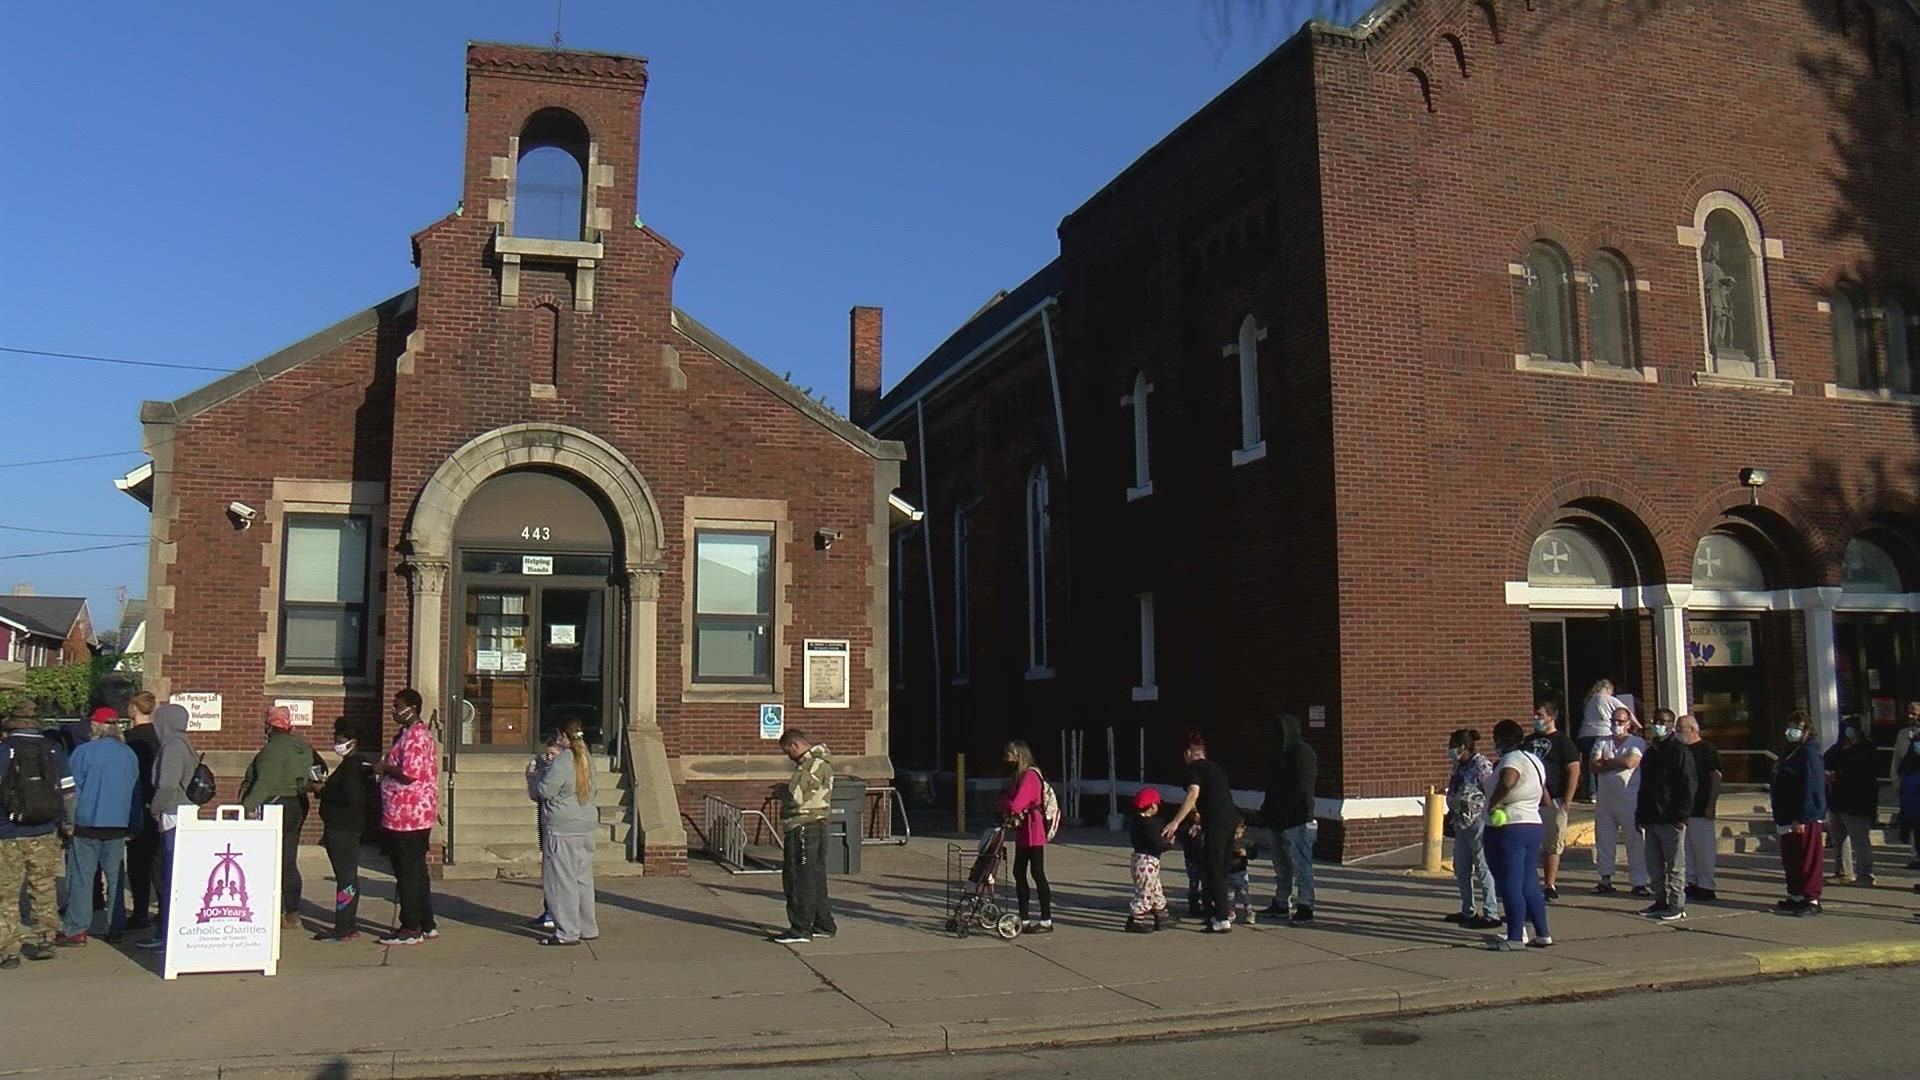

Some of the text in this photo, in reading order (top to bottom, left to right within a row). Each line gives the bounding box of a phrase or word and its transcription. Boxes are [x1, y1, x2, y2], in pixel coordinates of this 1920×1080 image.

[521, 526, 551, 541] 443
[525, 558, 551, 566] Helping
[187, 694, 207, 704] Parking
[191, 703, 201, 711] For
[290, 703, 299, 712] NO
[189, 720, 202, 729] Only
[222, 908, 247, 917] Years
[179, 925, 267, 936] Catholic Charities
